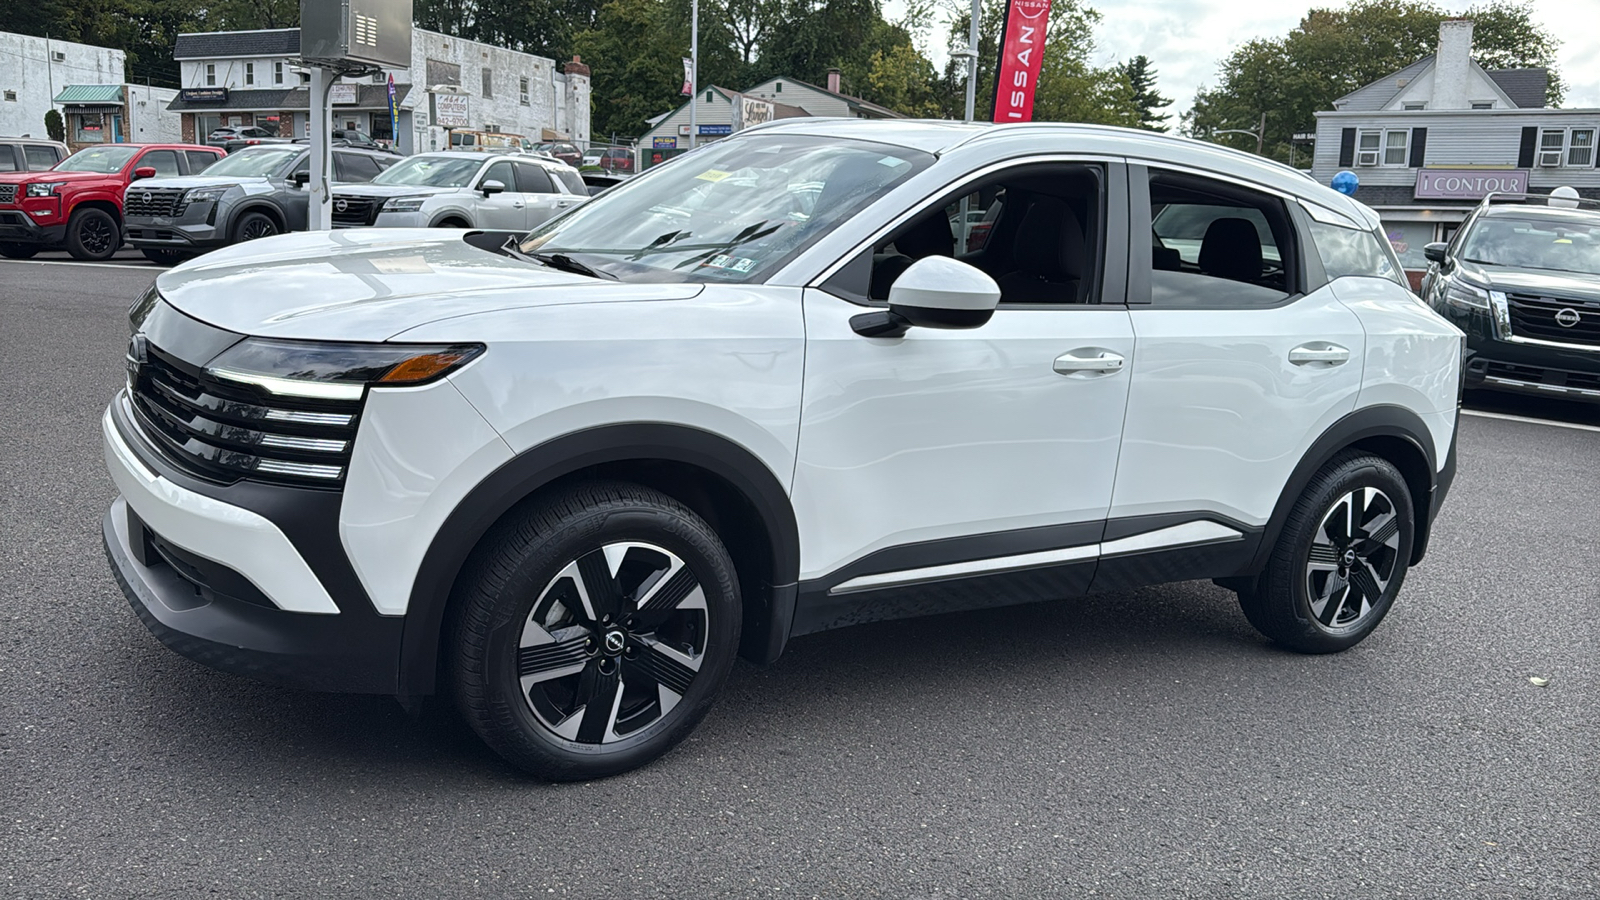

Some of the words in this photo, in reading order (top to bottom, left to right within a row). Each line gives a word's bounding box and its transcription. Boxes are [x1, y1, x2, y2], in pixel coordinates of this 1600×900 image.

[1015, 1, 1048, 9] NISSAN
[1008, 26, 1035, 118] ISSAN
[437, 102, 467, 111] COMPUTERS
[437, 116, 468, 126] 942-9700
[1434, 177, 1519, 192] CONTOUR
